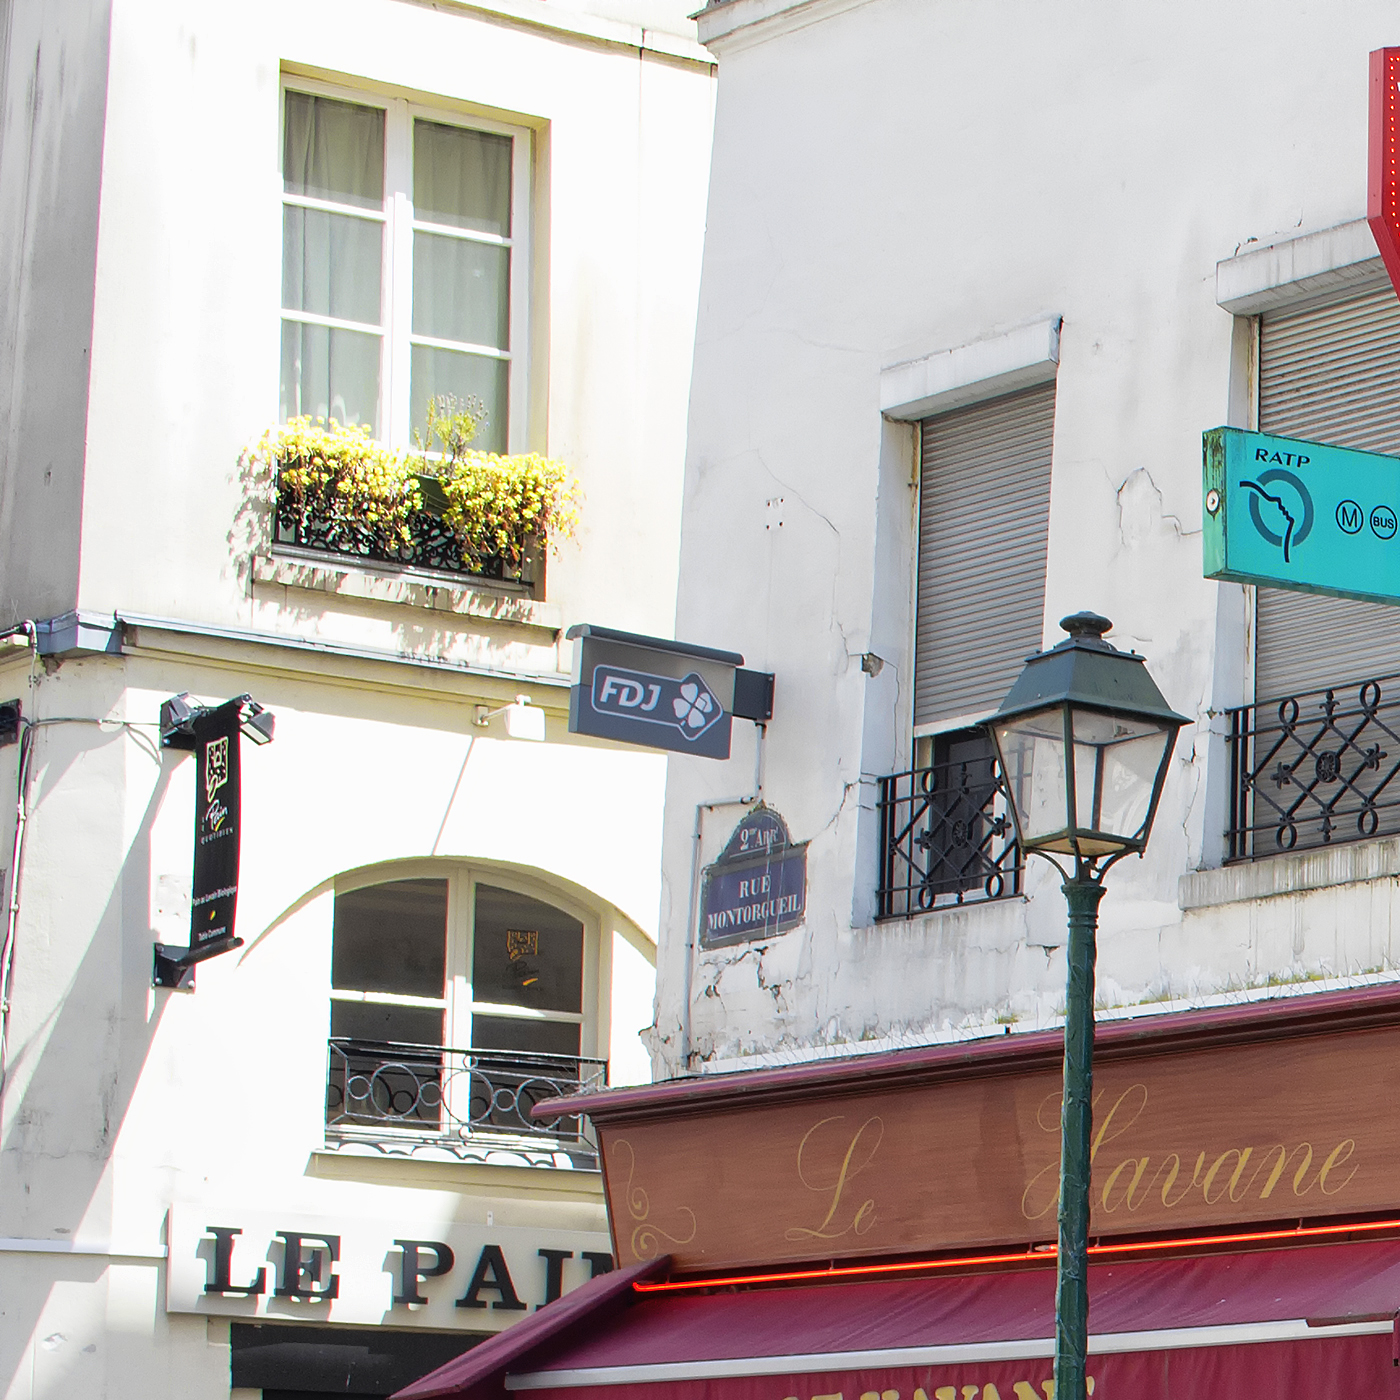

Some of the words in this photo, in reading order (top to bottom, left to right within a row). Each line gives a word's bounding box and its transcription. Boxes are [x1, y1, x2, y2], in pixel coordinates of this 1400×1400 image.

[1255, 448, 1311, 468] RATP
[1342, 506, 1358, 527] M
[1373, 513, 1395, 530] BUS
[600, 676, 662, 712] FDJ
[739, 875, 771, 899] RUE
[707, 895, 801, 931] MONTORGUEIL
[784, 1115, 884, 1242] Le
[1021, 1083, 1360, 1221] Havane
[203, 1226, 341, 1299] LE
